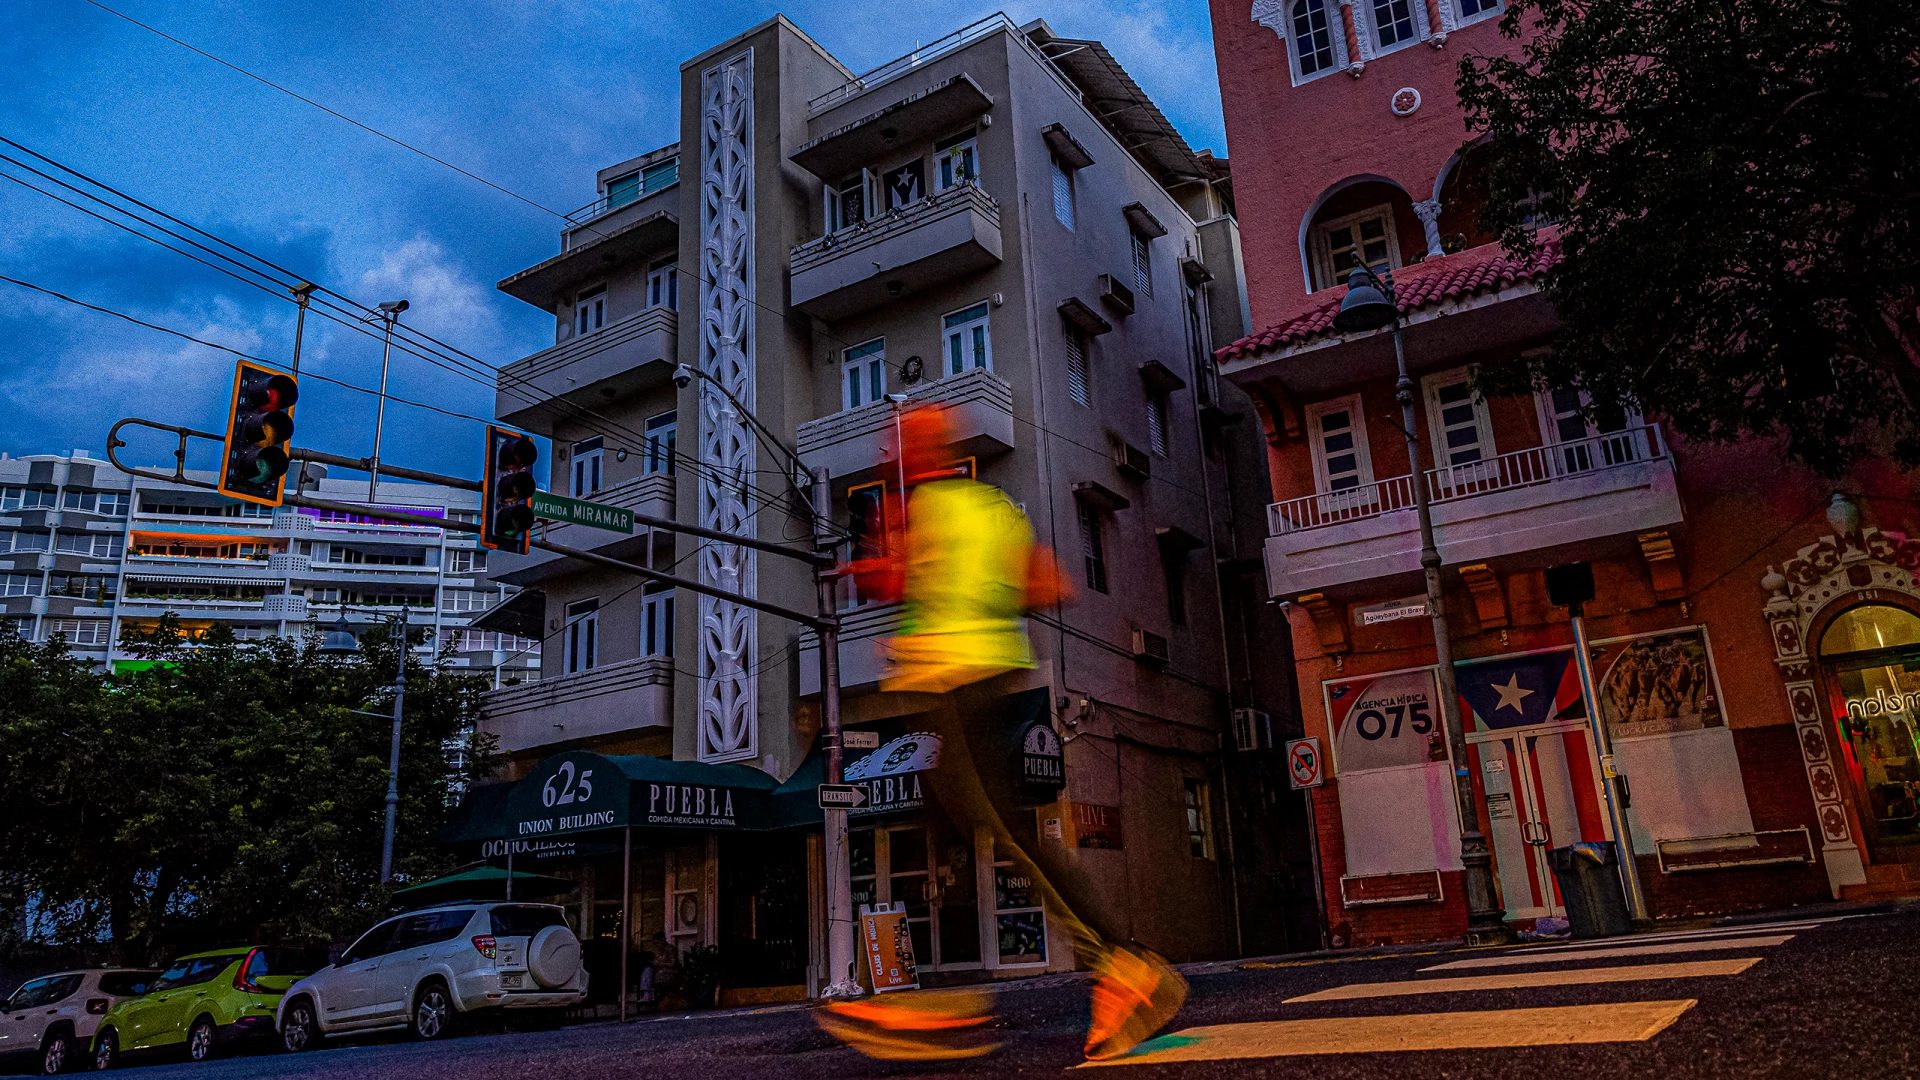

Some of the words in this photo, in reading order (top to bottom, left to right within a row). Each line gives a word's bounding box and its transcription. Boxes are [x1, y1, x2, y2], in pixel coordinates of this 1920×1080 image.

[533, 501, 568, 517] AVENIDA
[573, 504, 628, 529] MIRAMAR
[1356, 698, 1396, 711] AGENCIA
[1356, 702, 1433, 741] 075
[1023, 757, 1061, 777] PUEBLA
[542, 760, 594, 808] 625
[858, 774, 923, 805] EBLA
[649, 784, 735, 817] PUEBLA
[823, 791, 853, 802] TRANSITO
[899, 800, 925, 809] CANTINA
[519, 818, 554, 835] UNION
[559, 810, 615, 830] BUILDING
[647, 815, 673, 823] COMIDA
[673, 816, 705, 825] MEXICANA
[710, 818, 736, 826] CANTINA
[1080, 804, 1108, 826] LIVE
[1006, 876, 1031, 889] 1800
[888, 976, 903, 984] LIVE
